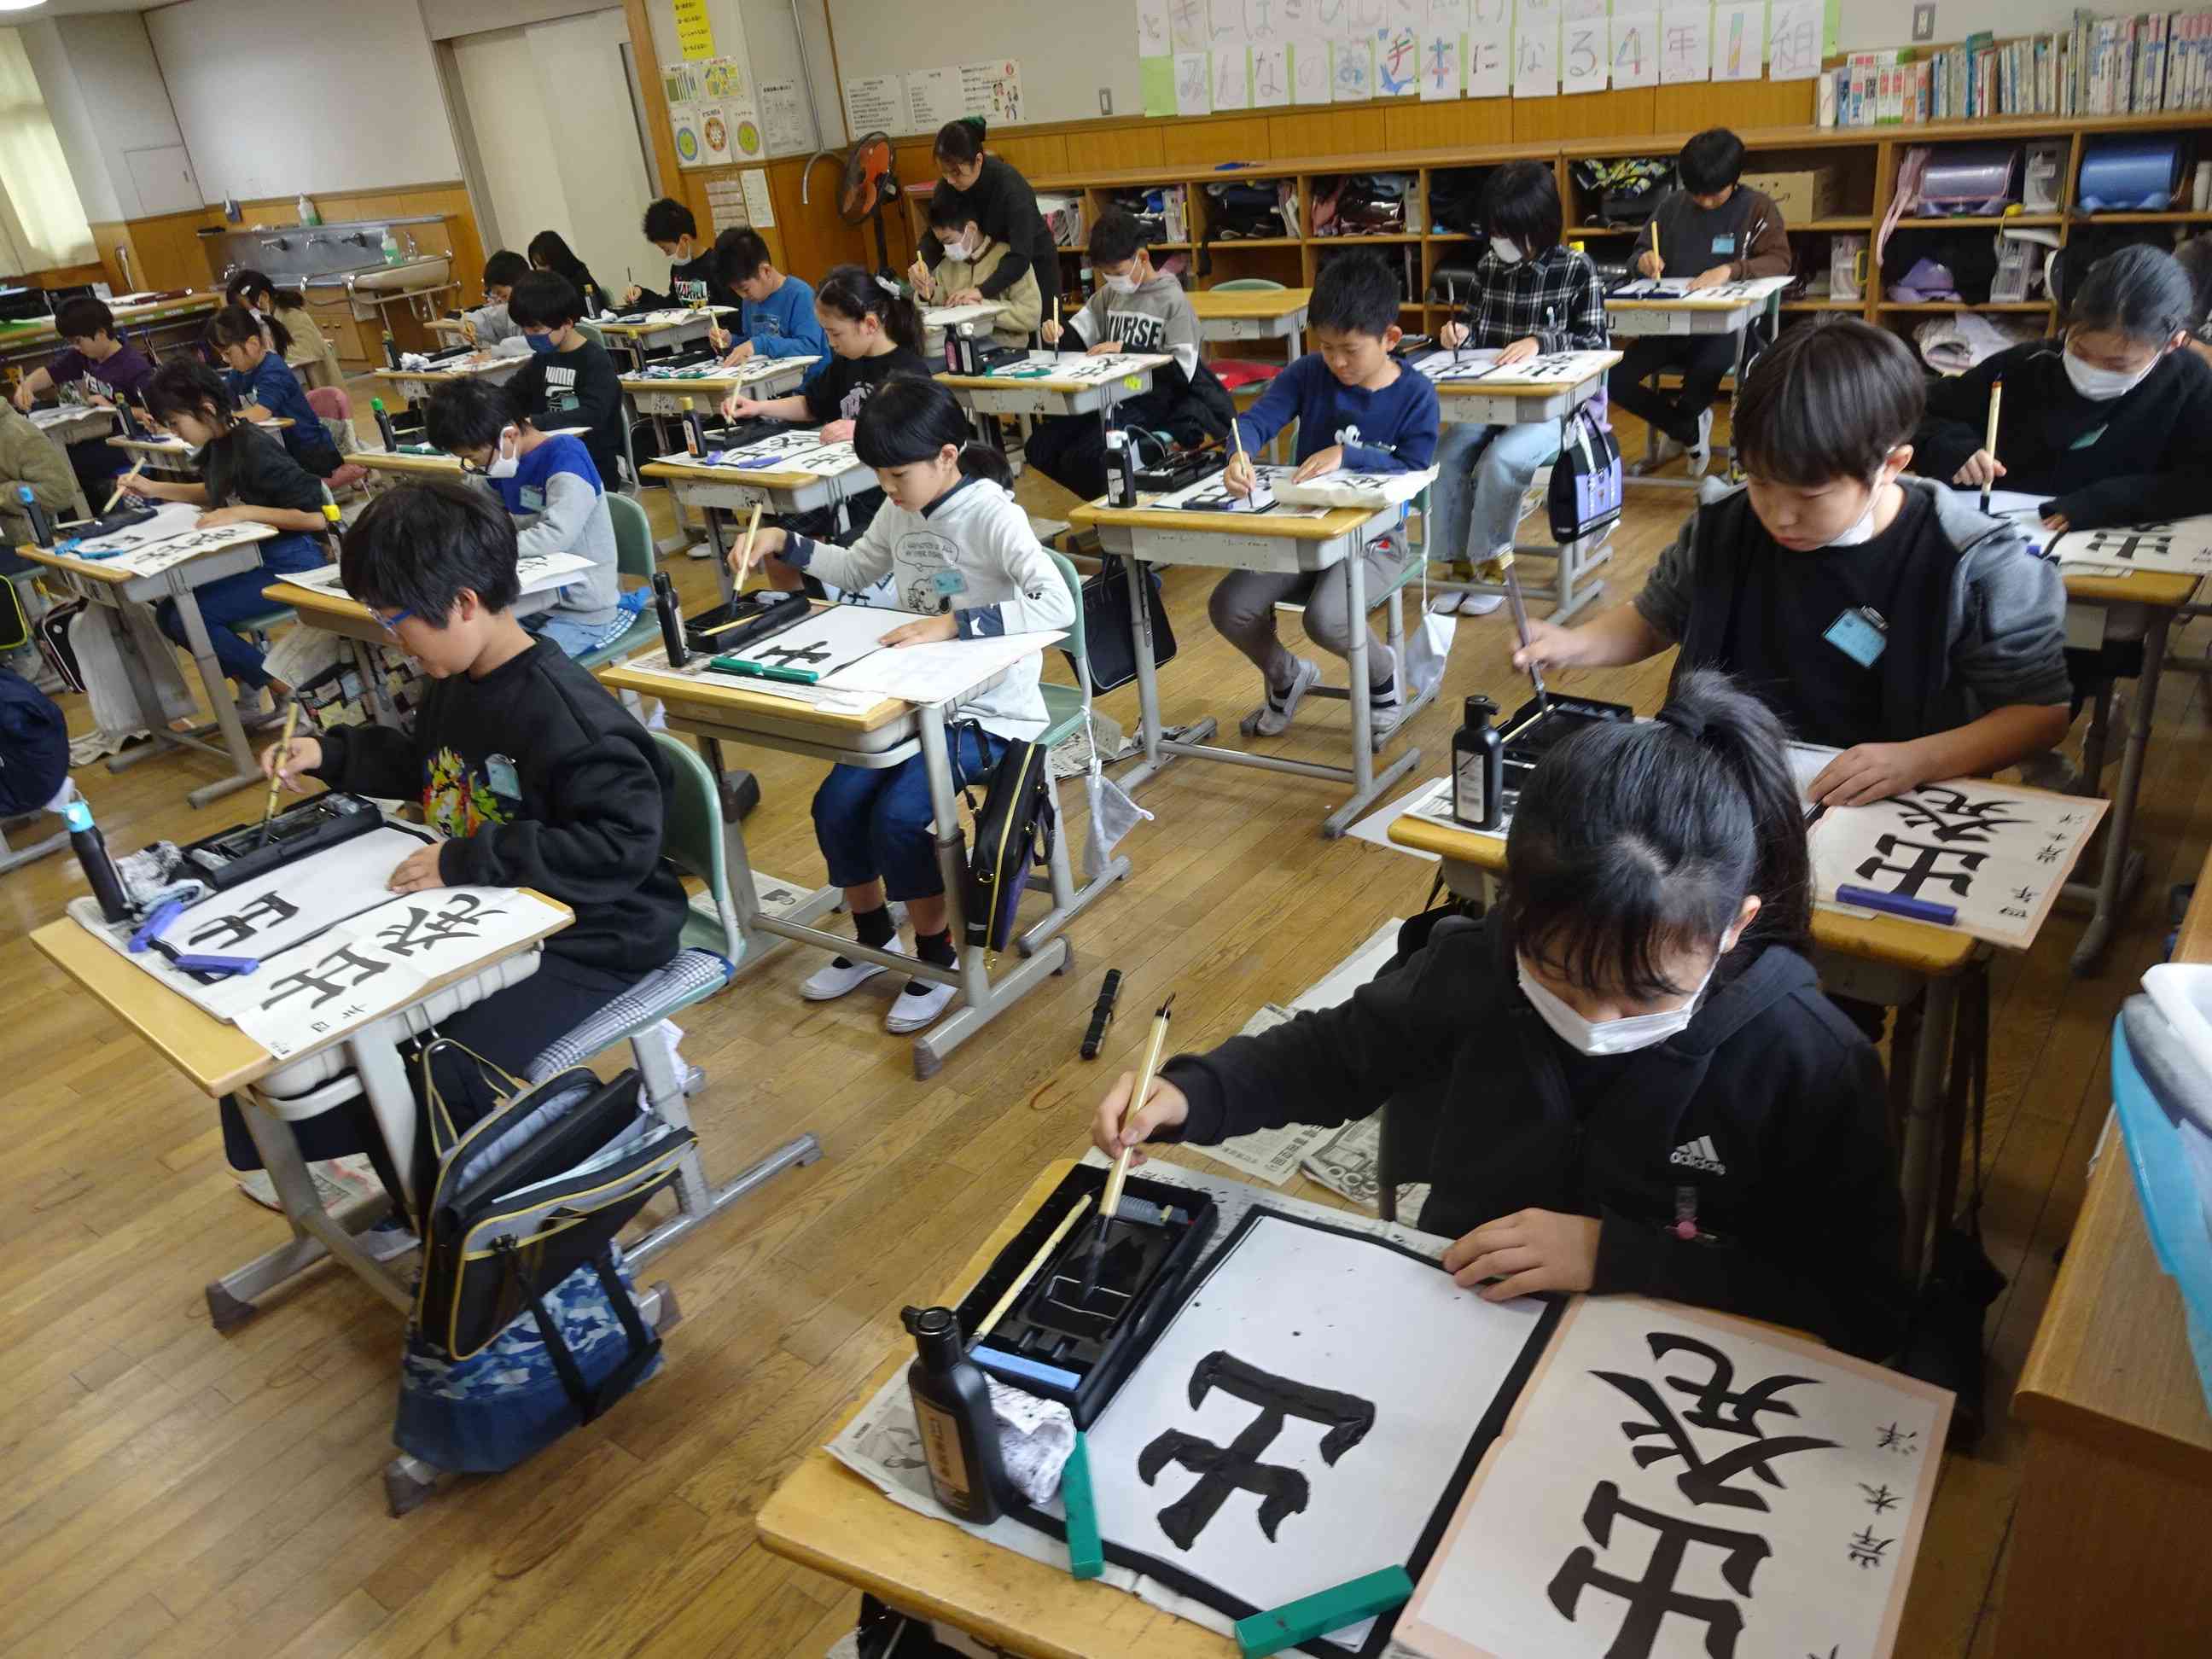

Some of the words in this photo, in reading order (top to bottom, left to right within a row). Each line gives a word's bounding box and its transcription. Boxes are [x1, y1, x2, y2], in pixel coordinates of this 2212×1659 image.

[1854, 785, 2035, 899] 出発
[260, 893, 509, 1011] 出発
[1548, 1331, 1842, 1659] 出発
